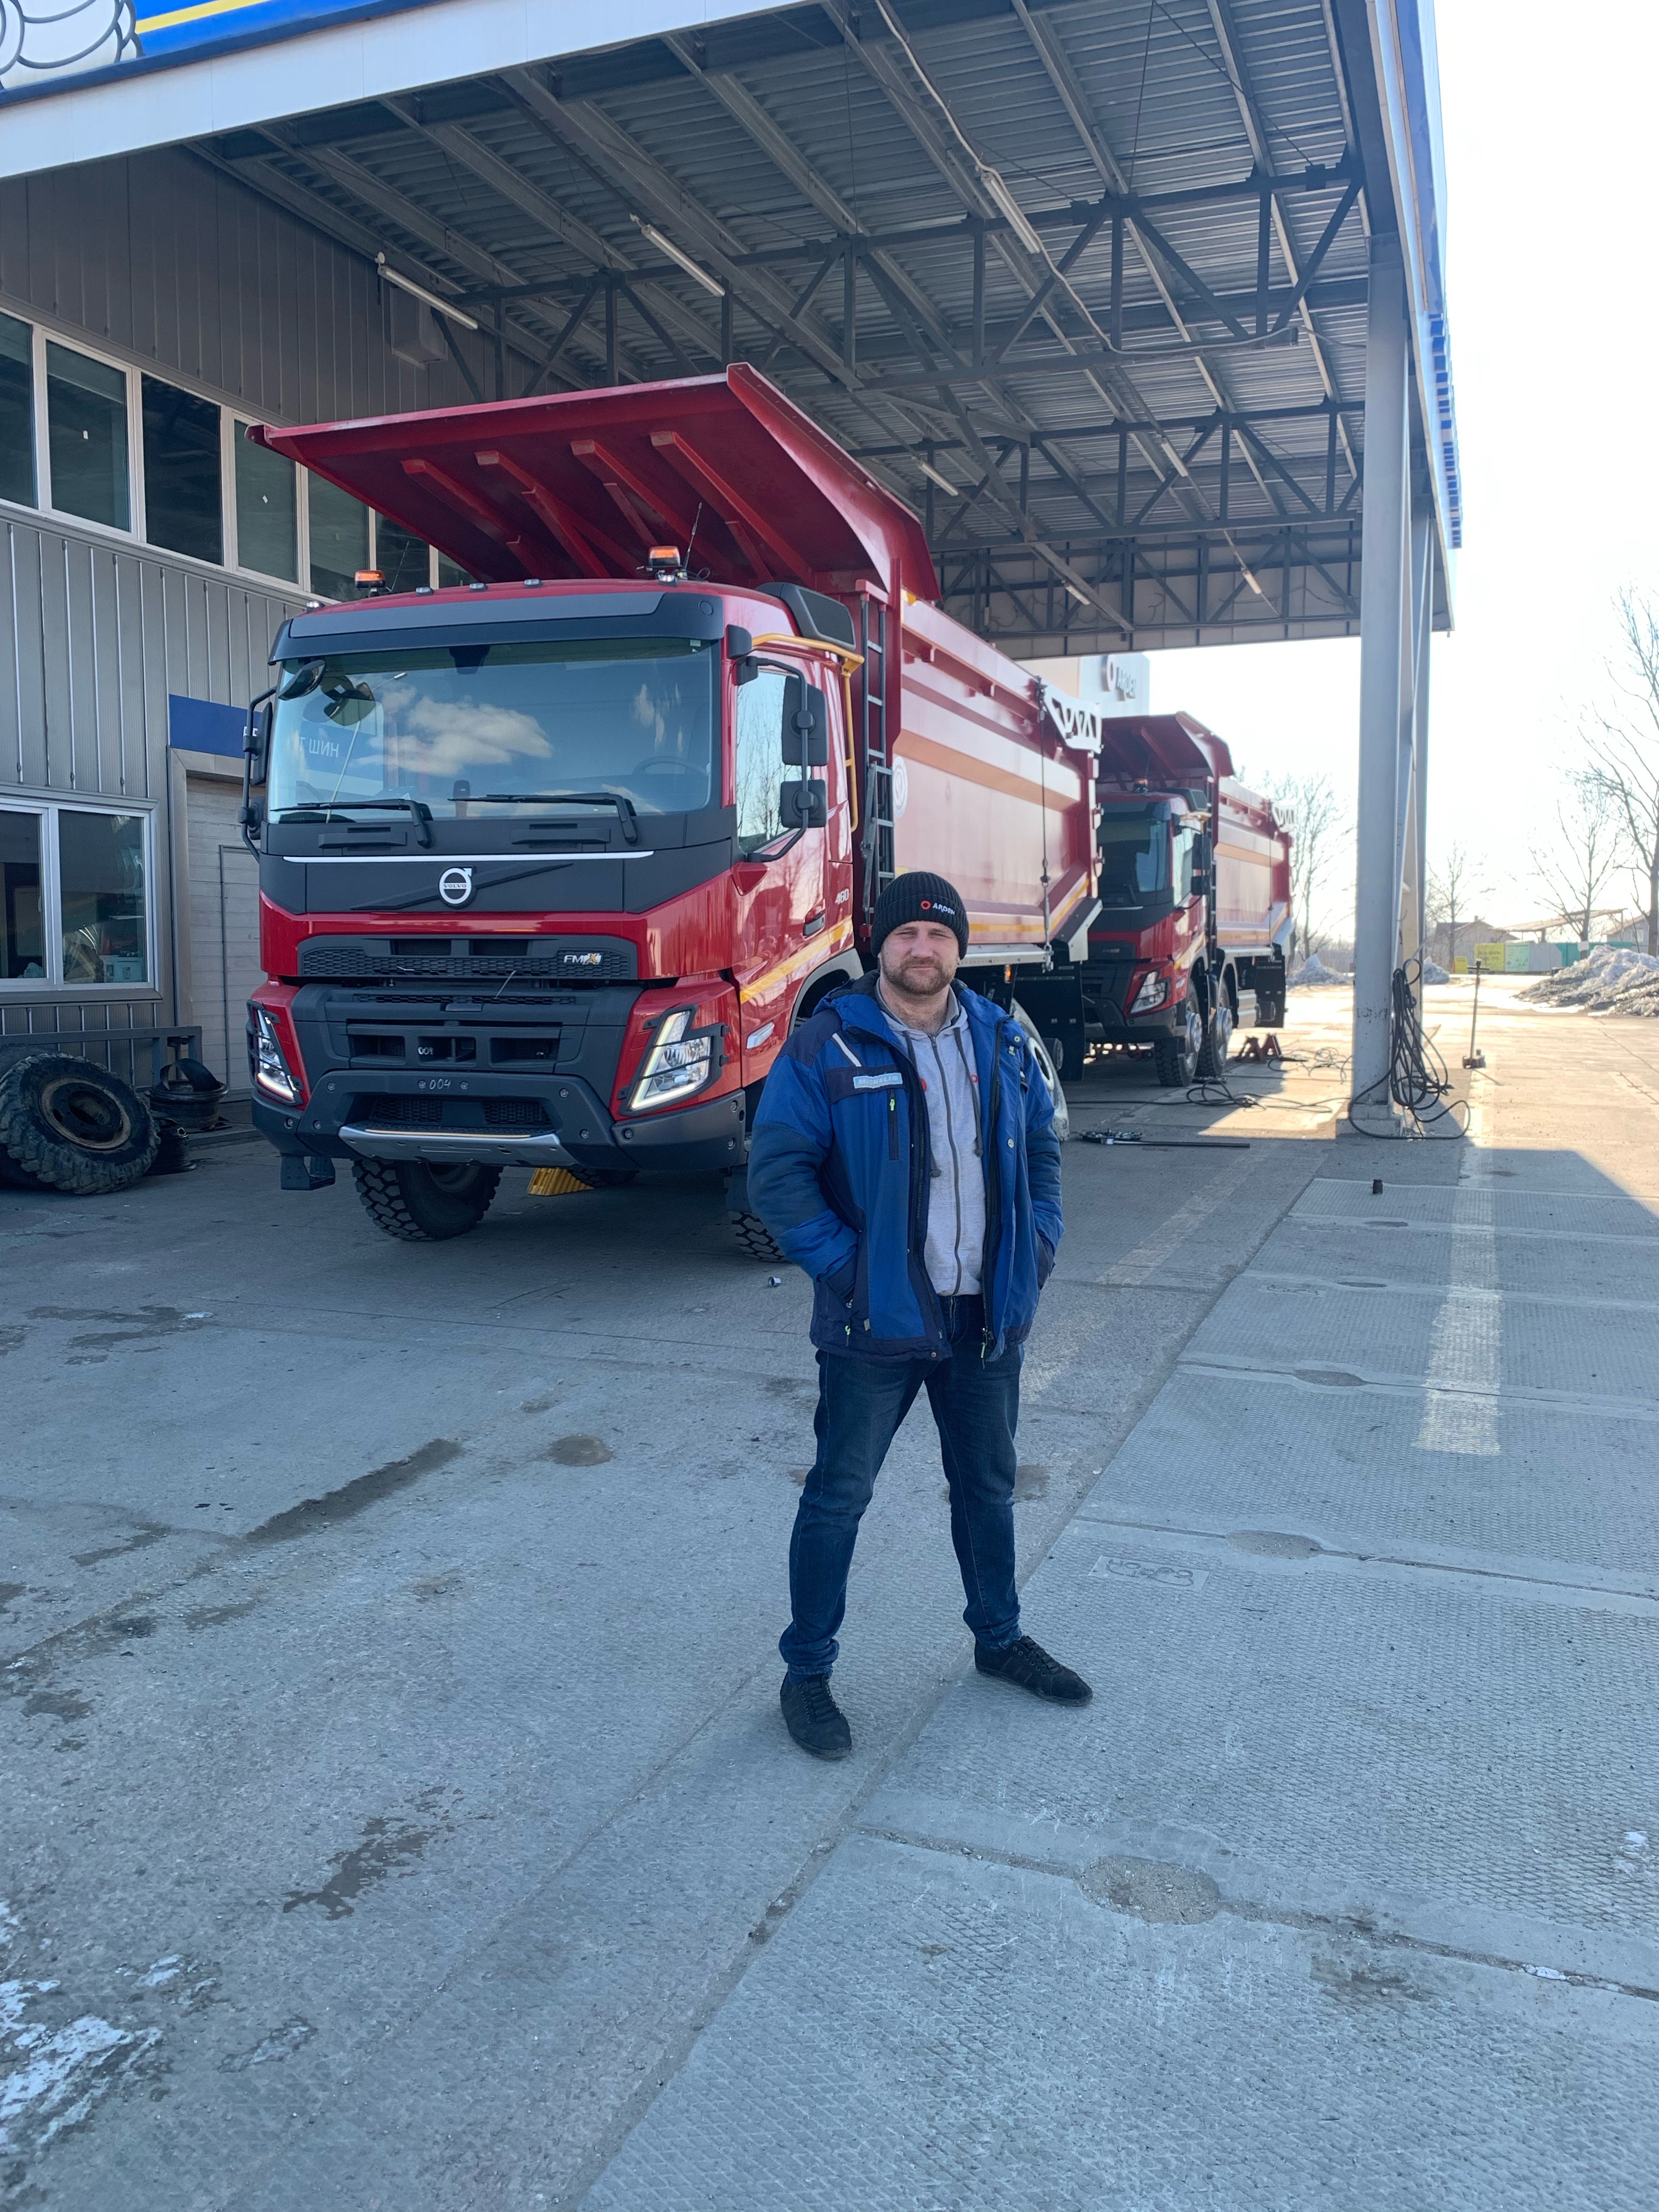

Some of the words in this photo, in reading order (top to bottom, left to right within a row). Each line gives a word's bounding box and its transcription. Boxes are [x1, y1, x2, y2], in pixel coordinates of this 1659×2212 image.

[308, 737, 340, 758] ШИН
[835, 888, 849, 905] 460
[933, 902, 956, 915] ARDEN
[563, 953, 602, 965] FMX
[417, 1046, 433, 1055] 004
[429, 1079, 452, 1090] 004
[857, 1076, 899, 1085] MICHELIN
